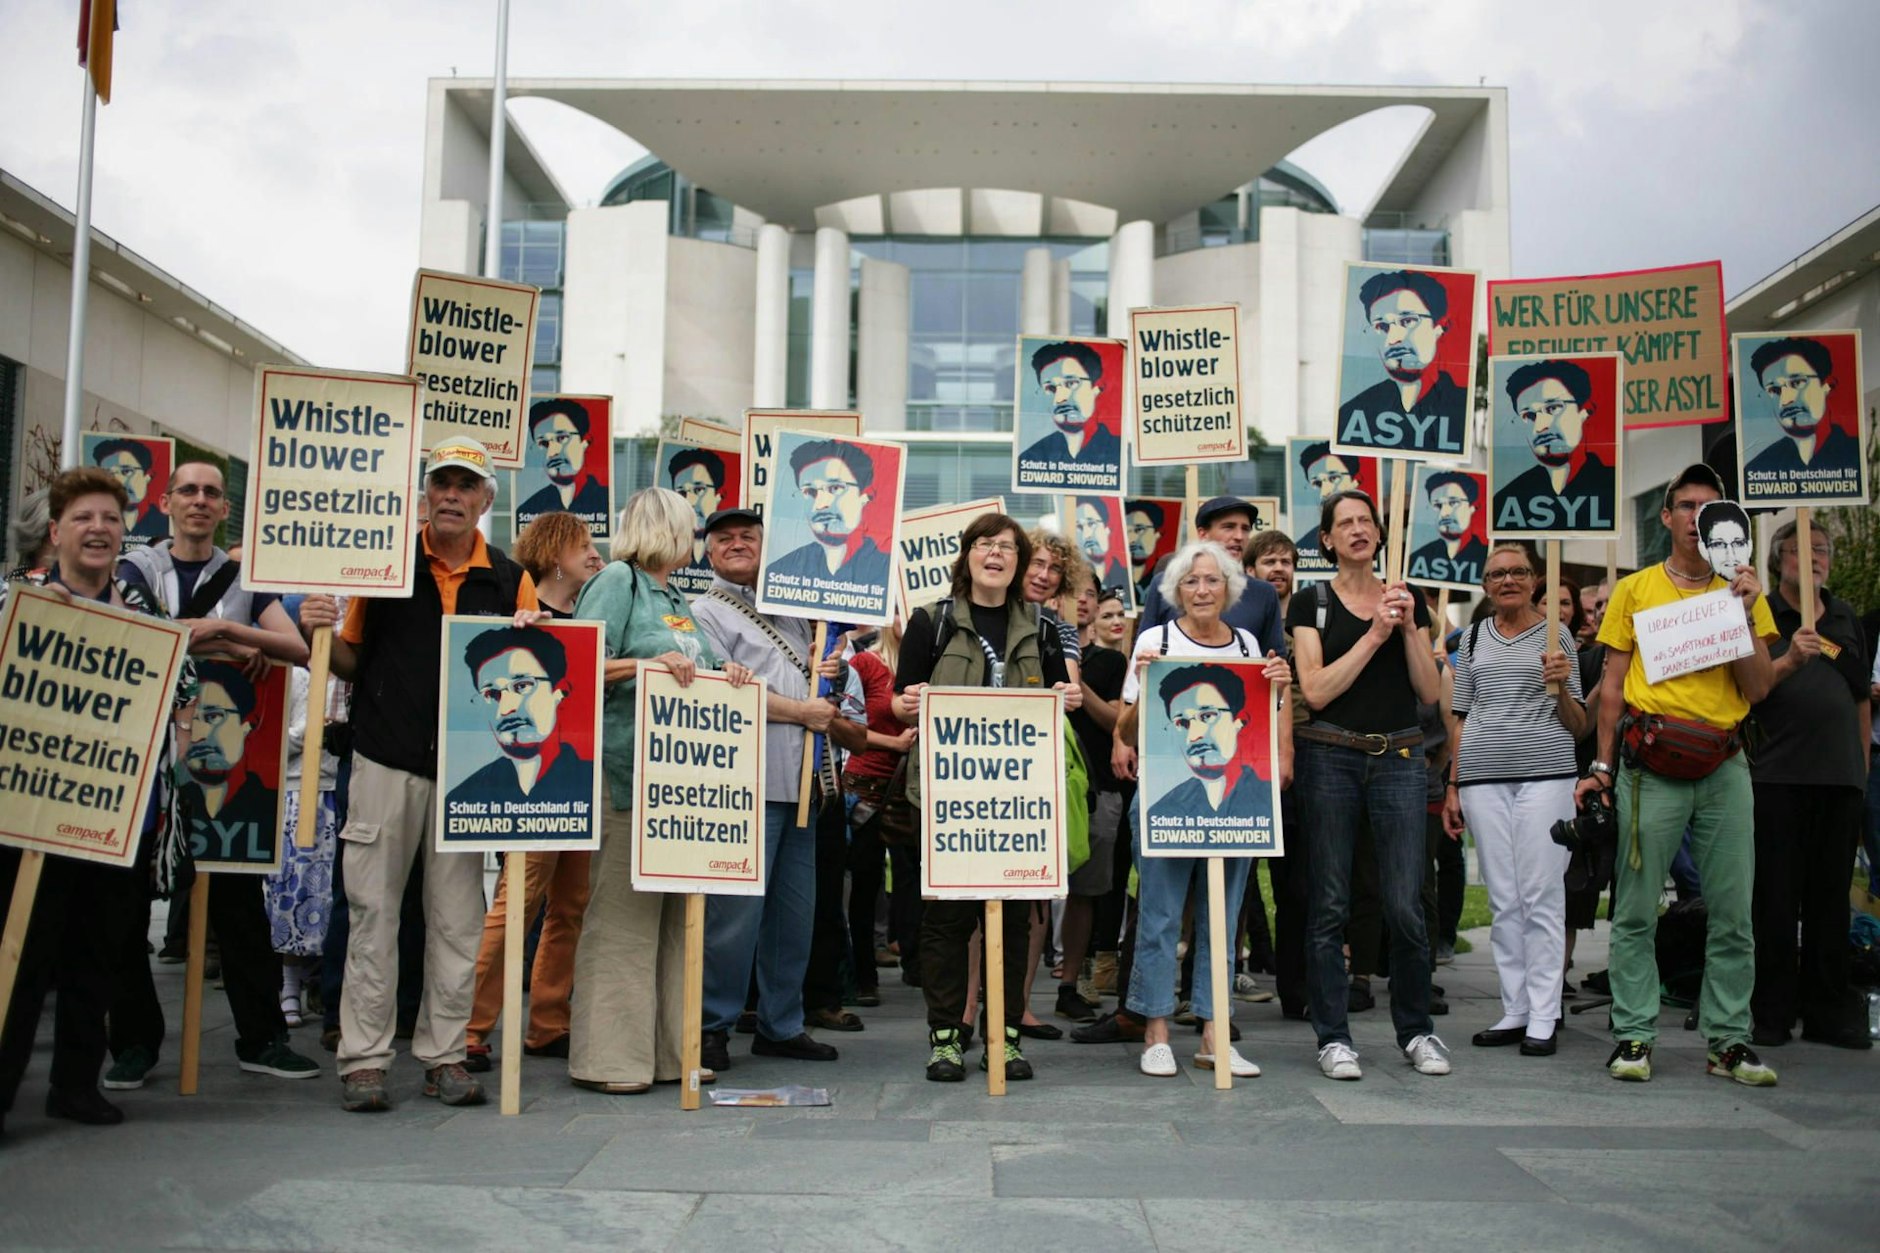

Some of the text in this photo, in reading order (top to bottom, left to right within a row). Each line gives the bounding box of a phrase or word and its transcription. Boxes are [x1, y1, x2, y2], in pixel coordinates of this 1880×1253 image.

[423, 297, 524, 335] Whistle-
[1495, 286, 1699, 328] WER FÜR UNSERE
[418, 328, 507, 364] blower
[1139, 327, 1231, 352] Whistle-
[1617, 330, 1701, 366] KÄMPFT
[1141, 356, 1219, 379] blower
[1142, 387, 1235, 413] gesetzlich
[1623, 374, 1720, 415] SER ASYL
[270, 397, 405, 438] Whistle-
[423, 400, 512, 430] chützen!
[1142, 411, 1231, 434] schützen!
[1340, 409, 1460, 451] ASYL
[268, 436, 385, 473] blower
[1020, 460, 1118, 473] Schutz in Deutschland für
[1020, 471, 1117, 486] EDWARD SNOWDEN
[1747, 468, 1857, 480] Schutz in Deutschland für
[1747, 480, 1858, 495] EDWARD SNOWDEN
[264, 488, 402, 517] gesetzlich
[596, 512, 607, 521] für
[1496, 495, 1612, 529] ASYL
[261, 520, 394, 551] schützen!
[900, 531, 964, 562] Whis
[768, 572, 885, 595] Schutz in Deutschland für
[1409, 555, 1484, 584] ASYL
[767, 585, 883, 611] EDWARD SNOWDEN
[1681, 600, 1728, 625] CLEVER
[18, 621, 159, 686] Whistle-
[2, 664, 131, 724] blower
[649, 694, 753, 735] Whistle-
[933, 716, 1048, 747] Whistle-
[649, 731, 739, 769] blower
[935, 752, 1033, 781] blower
[0, 762, 125, 813] chützen!
[648, 782, 753, 811] gesetzlich
[449, 801, 589, 814] Schutz in Deutschland für
[935, 796, 1052, 824] gesetzlich
[1151, 815, 1270, 827] Schutz in Deutschland für
[189, 818, 271, 859] SYL
[449, 817, 587, 834] EDWARD SNOWDEN
[647, 814, 748, 844] schützen!
[935, 828, 1047, 852] schützen!
[1151, 829, 1271, 844] EDWARD SNOWDEN
